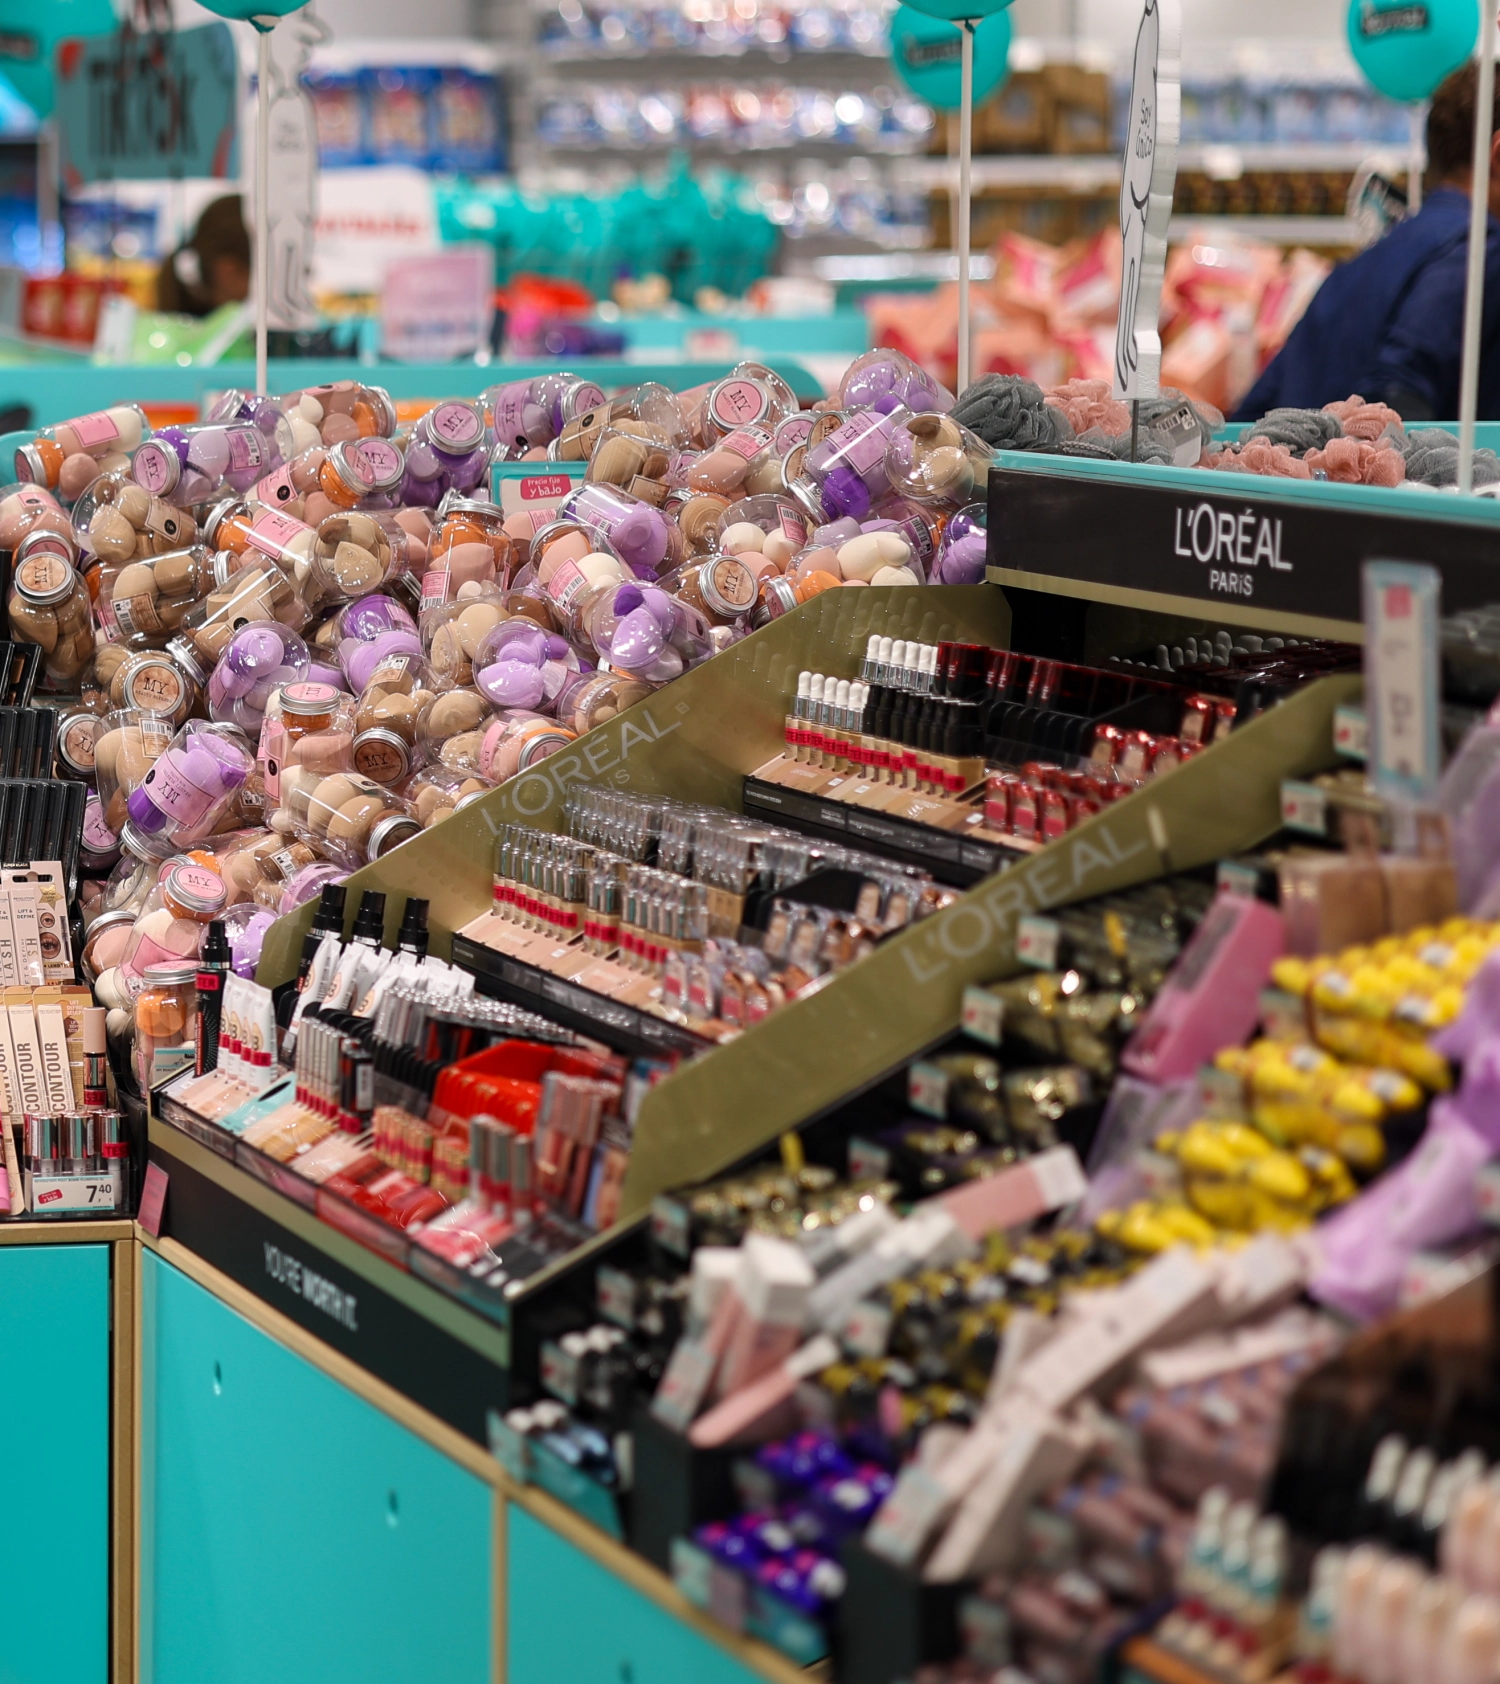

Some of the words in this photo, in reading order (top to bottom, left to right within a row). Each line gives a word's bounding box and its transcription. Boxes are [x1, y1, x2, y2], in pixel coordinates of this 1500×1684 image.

[730, 390, 752, 415] MY
[443, 411, 464, 432] MY
[146, 456, 160, 480] MY
[365, 452, 389, 465] MY
[530, 488, 537, 498] y
[539, 483, 562, 495] bajo
[1175, 503, 1293, 570] L'ORÉAL
[723, 569, 739, 594] MY
[143, 677, 169, 694] MY
[364, 753, 388, 768] MY
[481, 709, 682, 837] L'ORÉAL
[187, 874, 211, 887] MY
[27, 938, 43, 984] LASH
[17, 1042, 41, 1112] CONTOUR
[45, 1042, 67, 1112] CONTOUR
